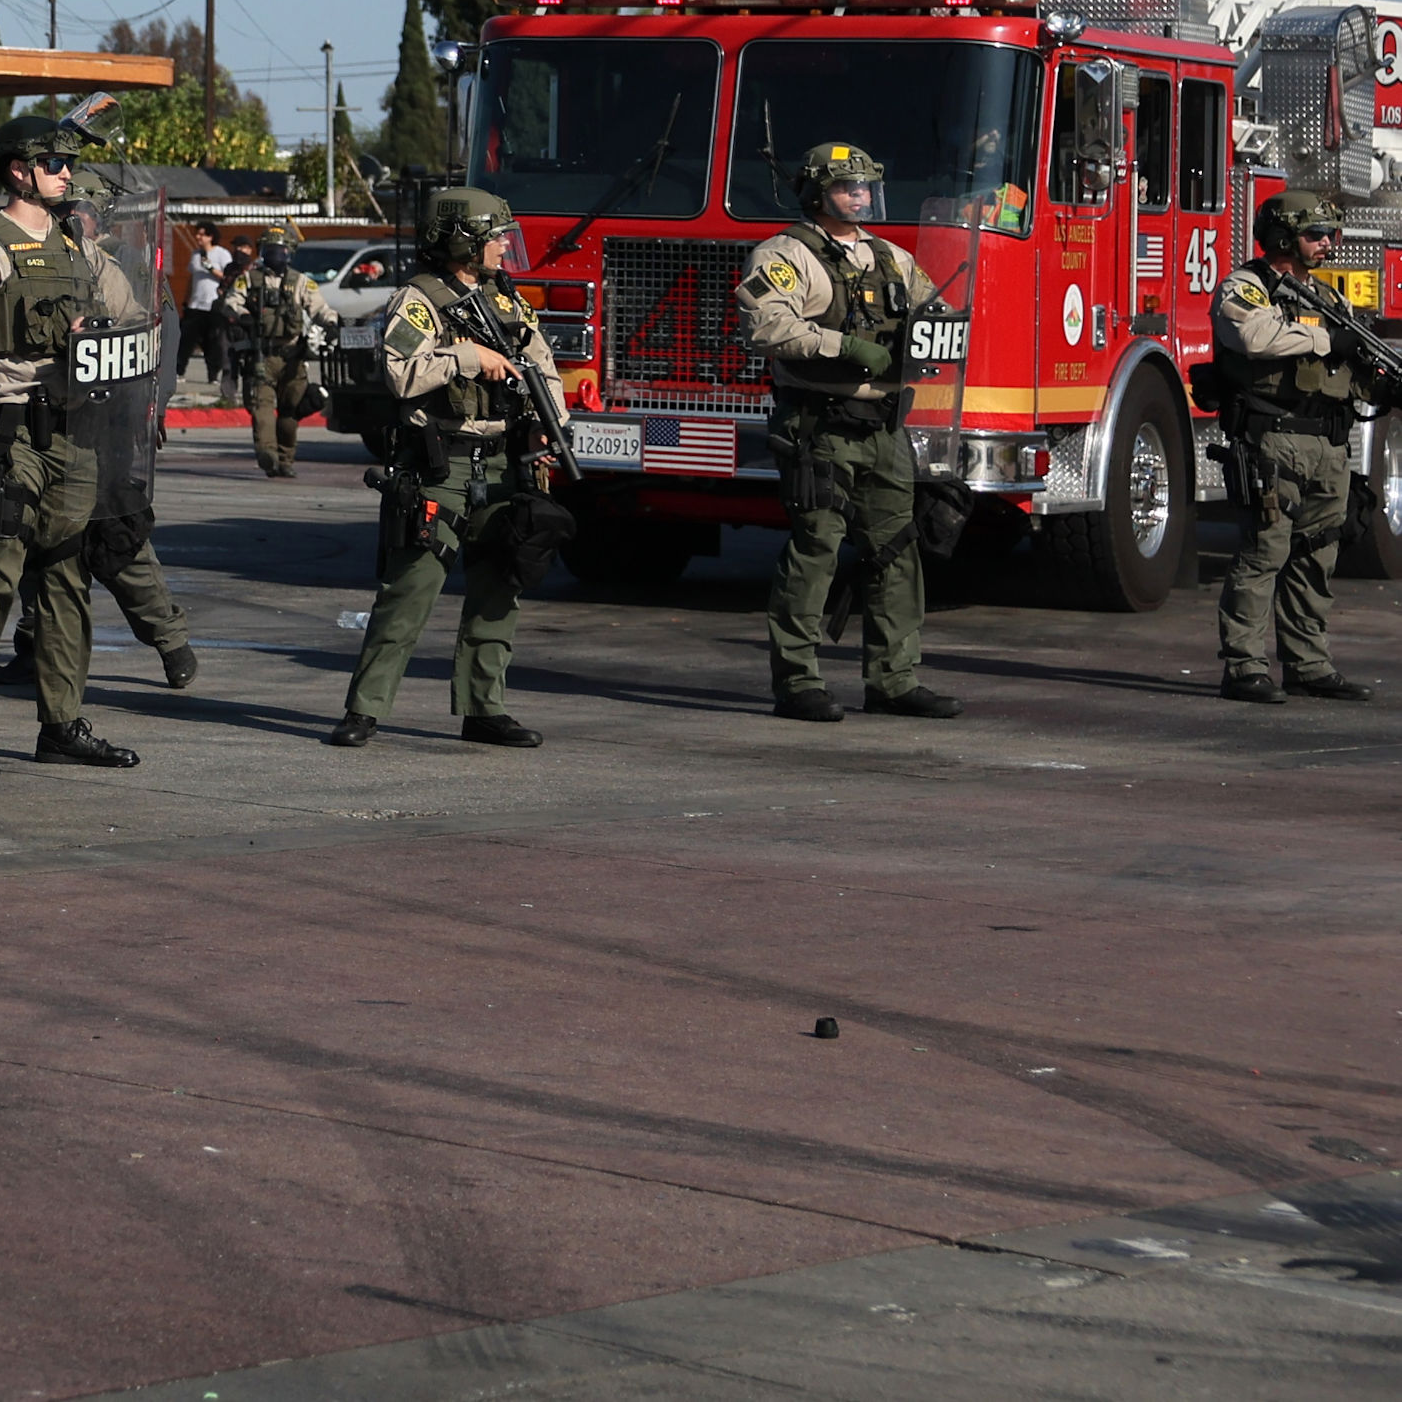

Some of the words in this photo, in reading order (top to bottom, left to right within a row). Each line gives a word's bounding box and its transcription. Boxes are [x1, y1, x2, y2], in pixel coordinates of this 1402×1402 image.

[1381, 105, 1402, 124] LOS
[1054, 225, 1066, 242] LOS
[1068, 225, 1095, 243] ANGELES
[1061, 251, 1087, 269] COUNTY
[1184, 227, 1218, 293] 45
[1054, 362, 1069, 381] FIRE
[1070, 362, 1088, 381] DEPT.
[577, 436, 640, 456] 1260919
